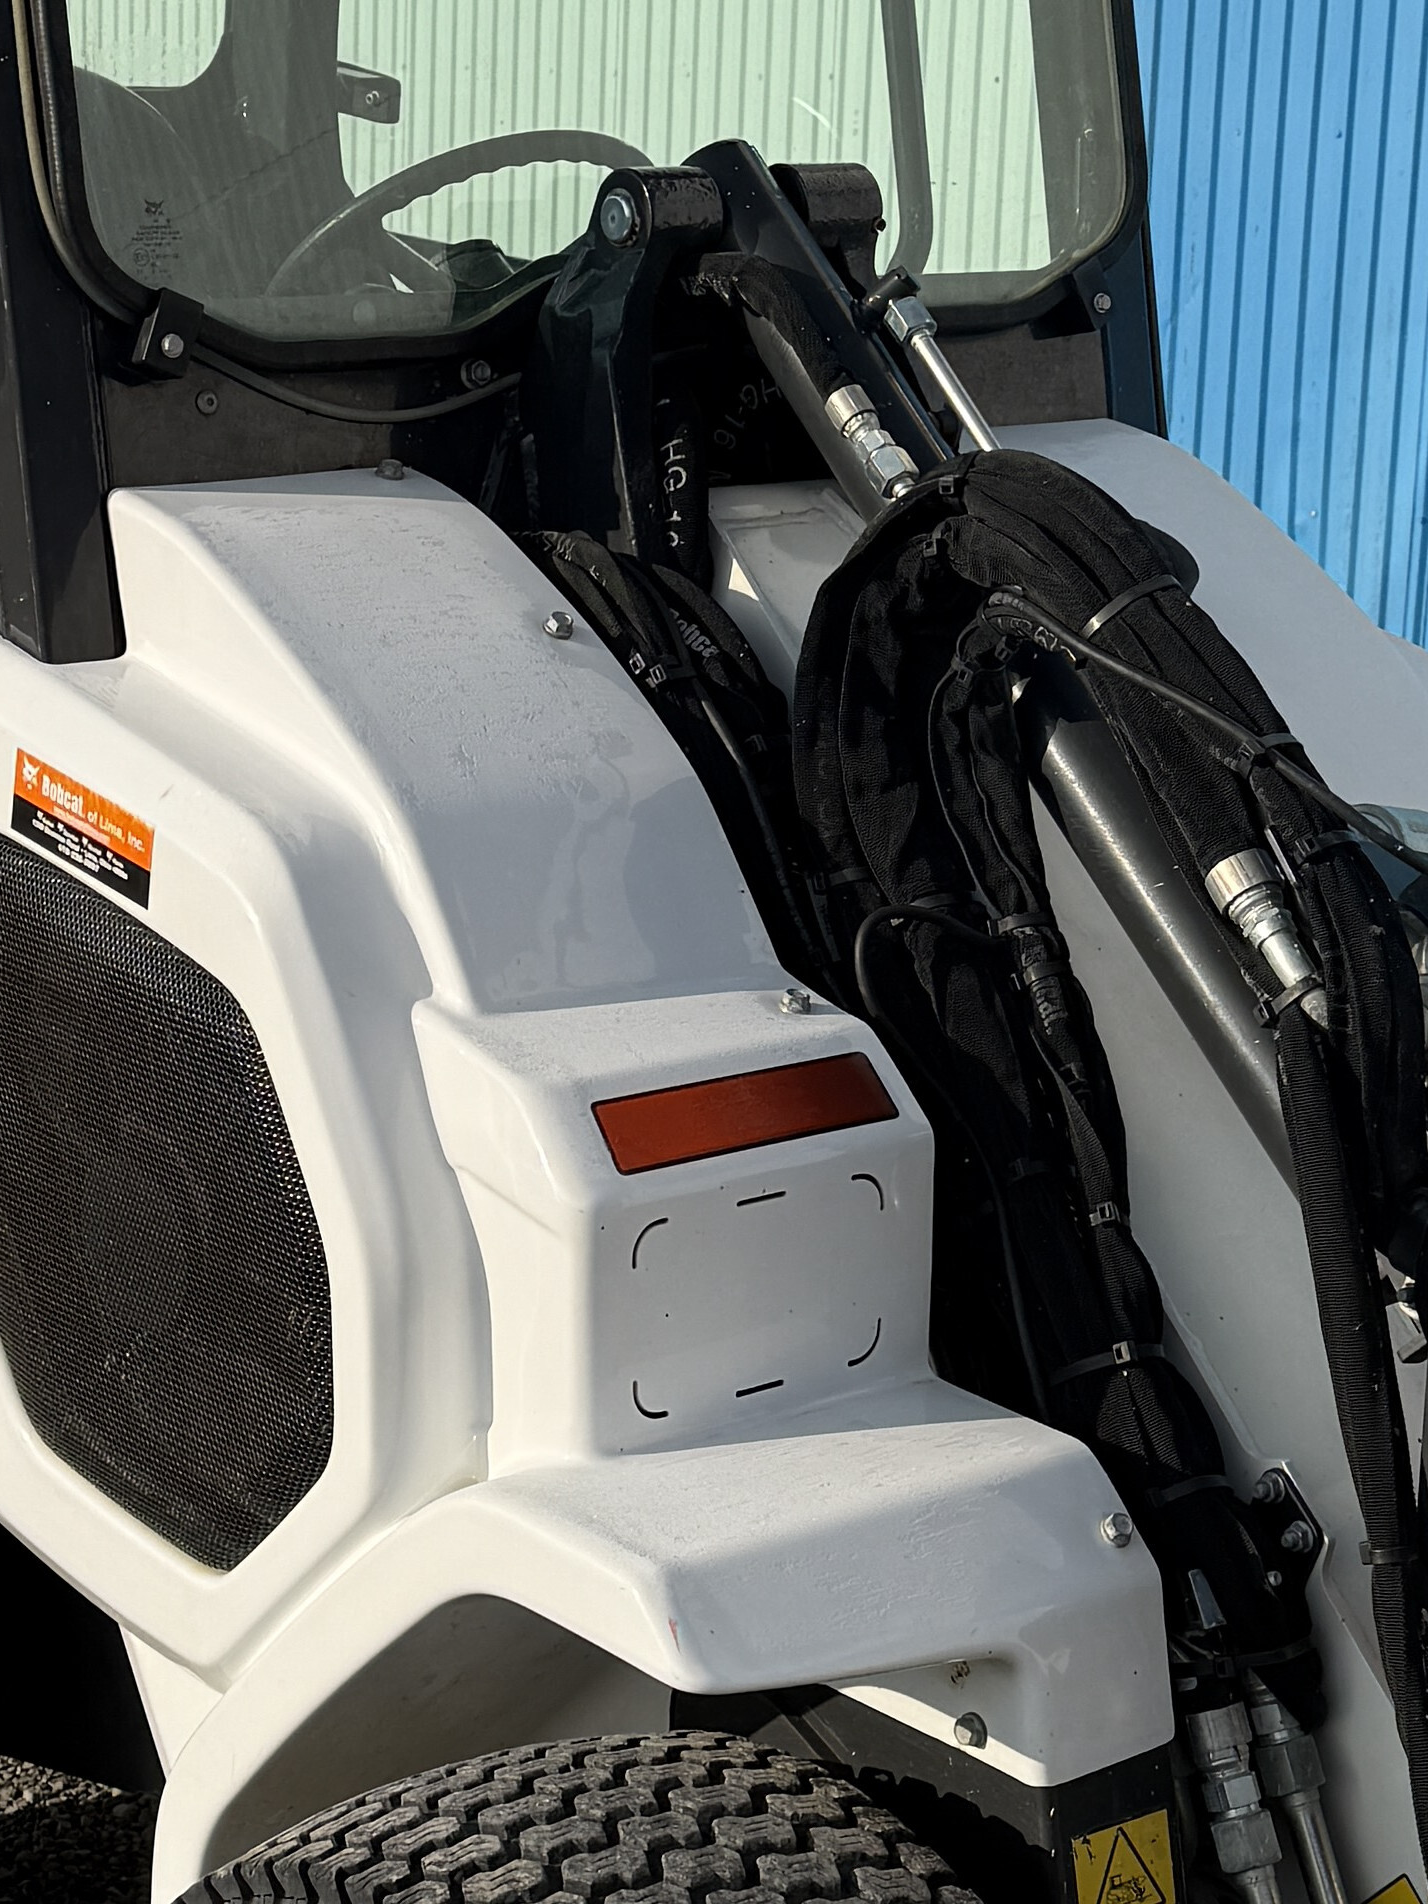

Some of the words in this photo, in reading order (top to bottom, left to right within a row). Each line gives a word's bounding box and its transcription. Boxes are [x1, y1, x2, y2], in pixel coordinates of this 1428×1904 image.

[41, 774, 86, 818] Bobcat
[87, 810, 99, 824] of
[98, 813, 126, 845] Lima,
